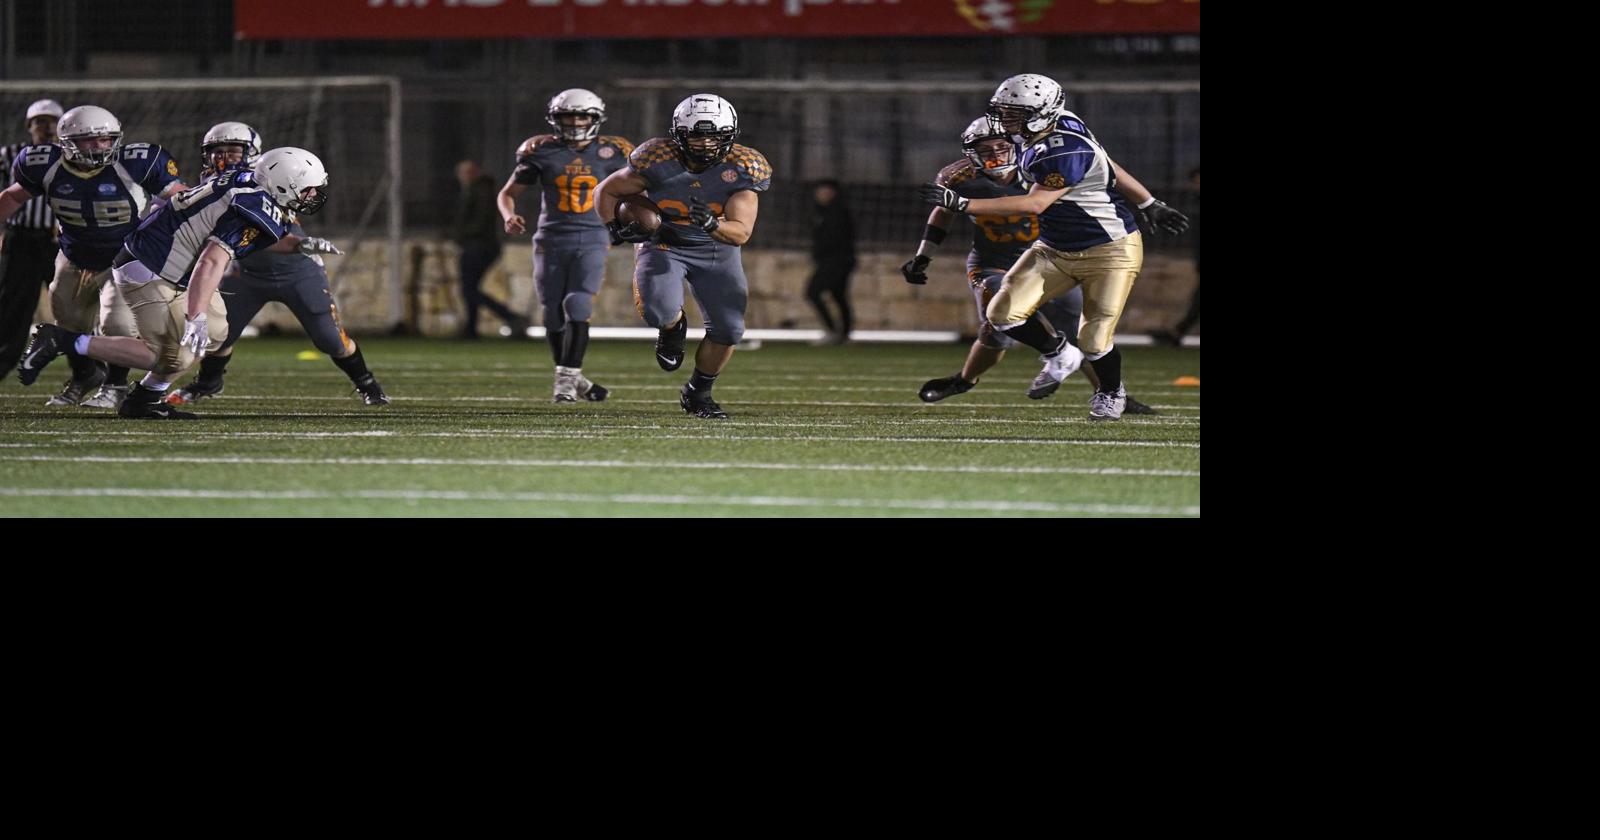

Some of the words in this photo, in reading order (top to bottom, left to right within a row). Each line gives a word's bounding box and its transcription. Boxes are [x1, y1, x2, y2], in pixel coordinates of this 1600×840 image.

[554, 175, 598, 213] 10
[50, 197, 133, 228] 58
[261, 195, 283, 227] 60
